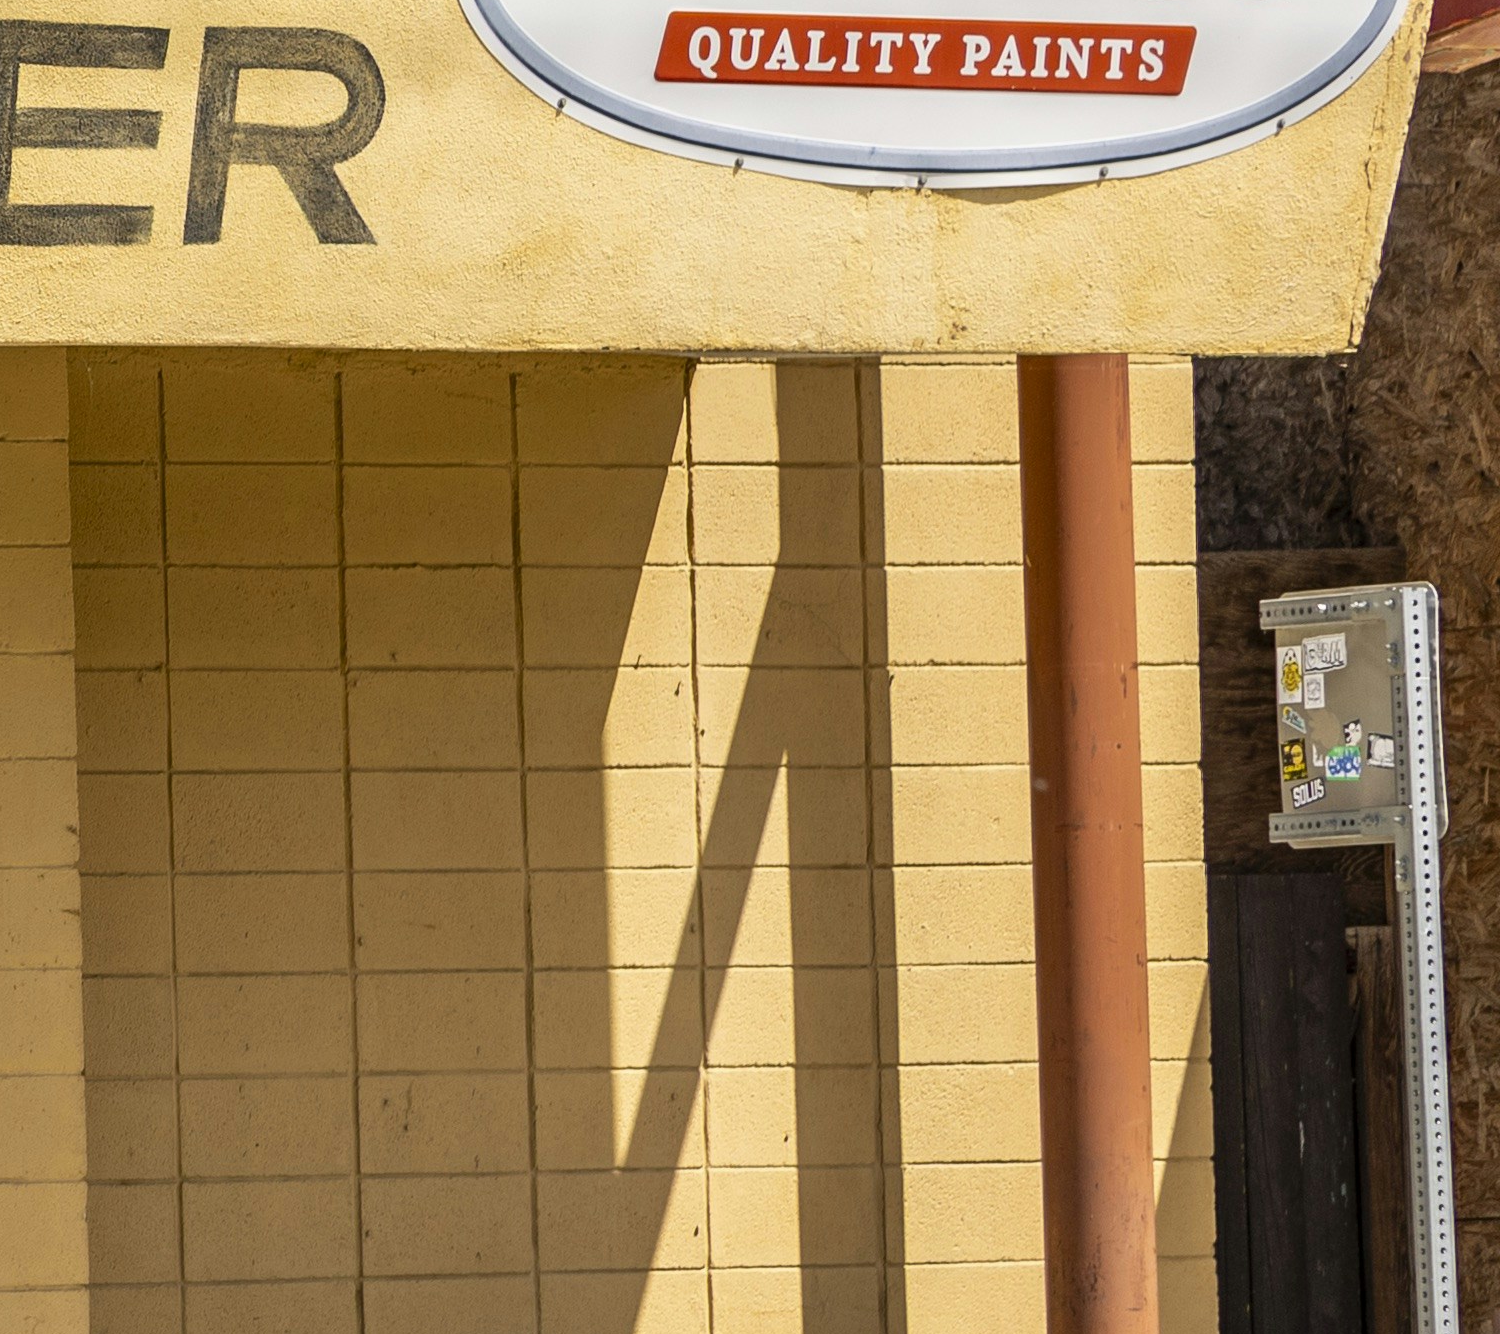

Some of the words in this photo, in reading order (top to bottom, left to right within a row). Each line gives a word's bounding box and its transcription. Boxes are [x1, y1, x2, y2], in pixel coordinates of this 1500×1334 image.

[688, 25, 938, 76] QUALITY
[960, 33, 1167, 82] PAINTS
[1292, 778, 1326, 810] SOLUS
